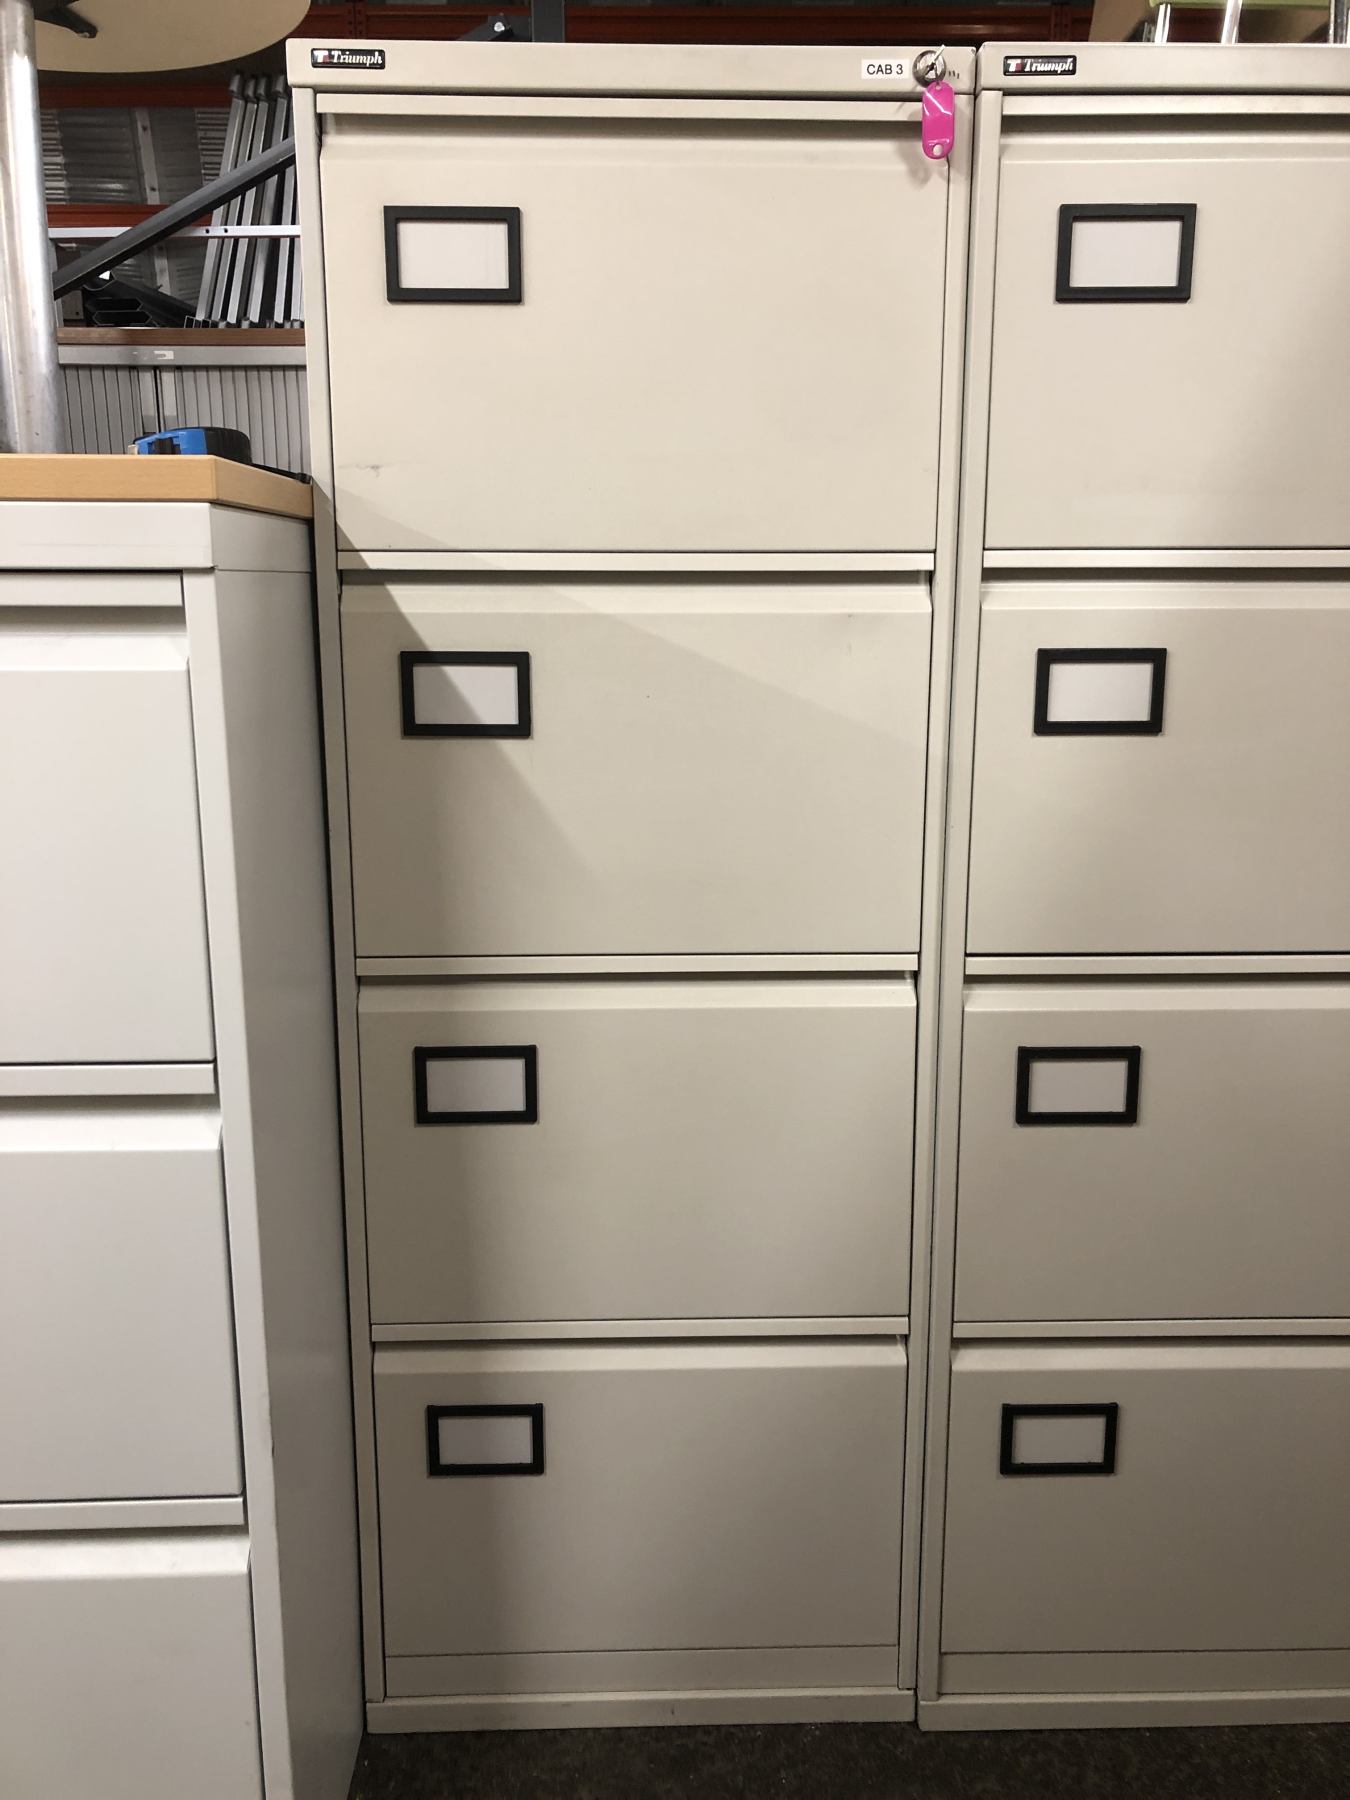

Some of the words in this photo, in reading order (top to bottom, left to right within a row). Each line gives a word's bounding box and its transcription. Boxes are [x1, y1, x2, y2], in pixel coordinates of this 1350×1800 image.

[331, 50, 382, 67] Triumph
[1024, 57, 1073, 74] Triumph
[866, 63, 893, 75] CAB
[896, 63, 904, 75] 3
